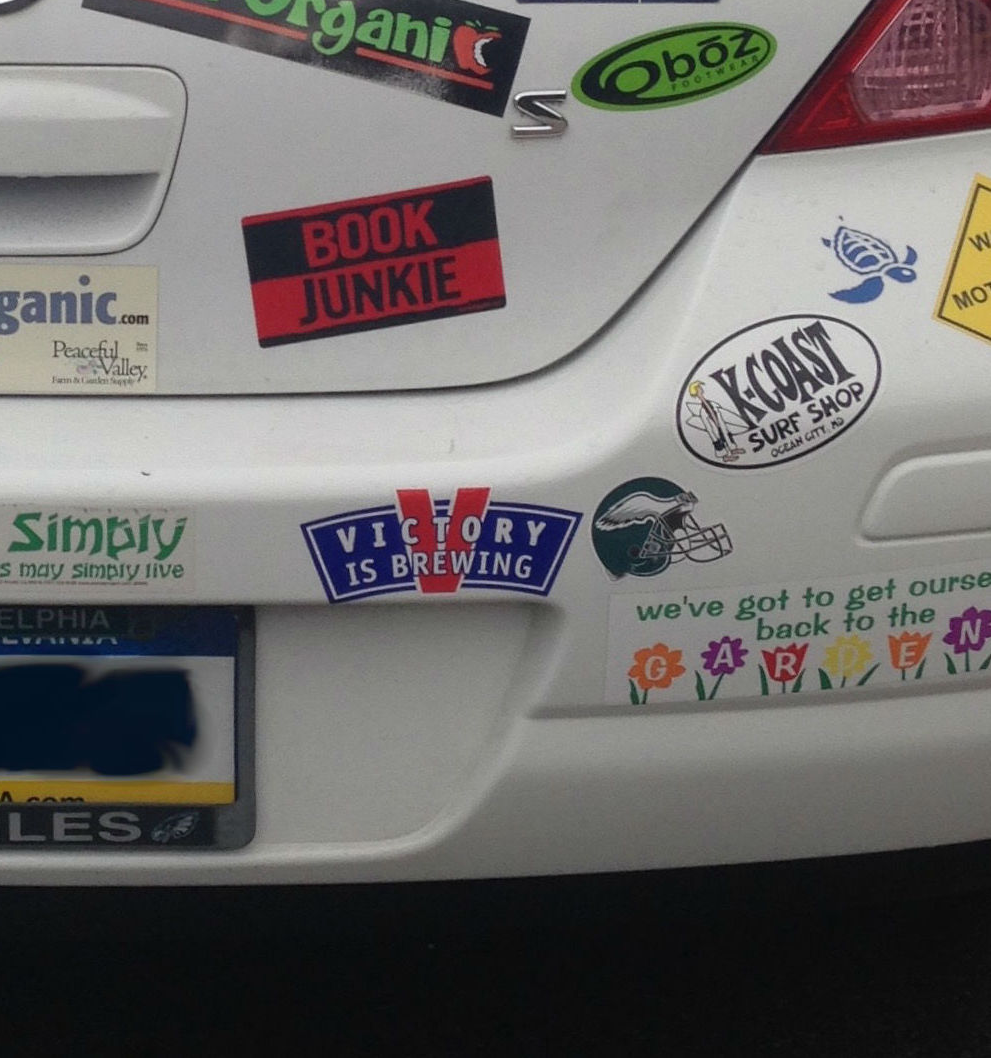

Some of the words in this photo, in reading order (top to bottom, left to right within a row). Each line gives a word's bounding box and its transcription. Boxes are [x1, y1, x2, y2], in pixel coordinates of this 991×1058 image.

[671, 55, 760, 91] FOOTWEAR
[512, 89, 568, 137] S
[300, 198, 438, 269] BOOK
[299, 255, 462, 327] JUNKIE
[52, 340, 119, 360] Peaceful
[100, 356, 149, 382] Valley
[52, 376, 72, 384] Farm
[74, 376, 81, 384] &
[82, 375, 109, 385] Garden
[708, 320, 856, 431] K-COAST
[749, 412, 802, 453] SURF
[807, 382, 864, 423] SHOP
[770, 435, 804, 458] OCEAN
[831, 417, 846, 431] MD
[7, 511, 189, 562] Simply
[336, 516, 546, 553] VICTORY
[19, 562, 63, 580] may
[72, 561, 141, 581] simply
[145, 561, 185, 579] live
[346, 558, 377, 586] IS
[391, 550, 533, 580] BREWING
[636, 595, 724, 621] we've
[734, 589, 788, 621] got
[802, 587, 835, 609] to
[847, 579, 897, 611] get
[756, 613, 830, 641] back
[844, 611, 875, 633] to
[888, 602, 936, 627] the
